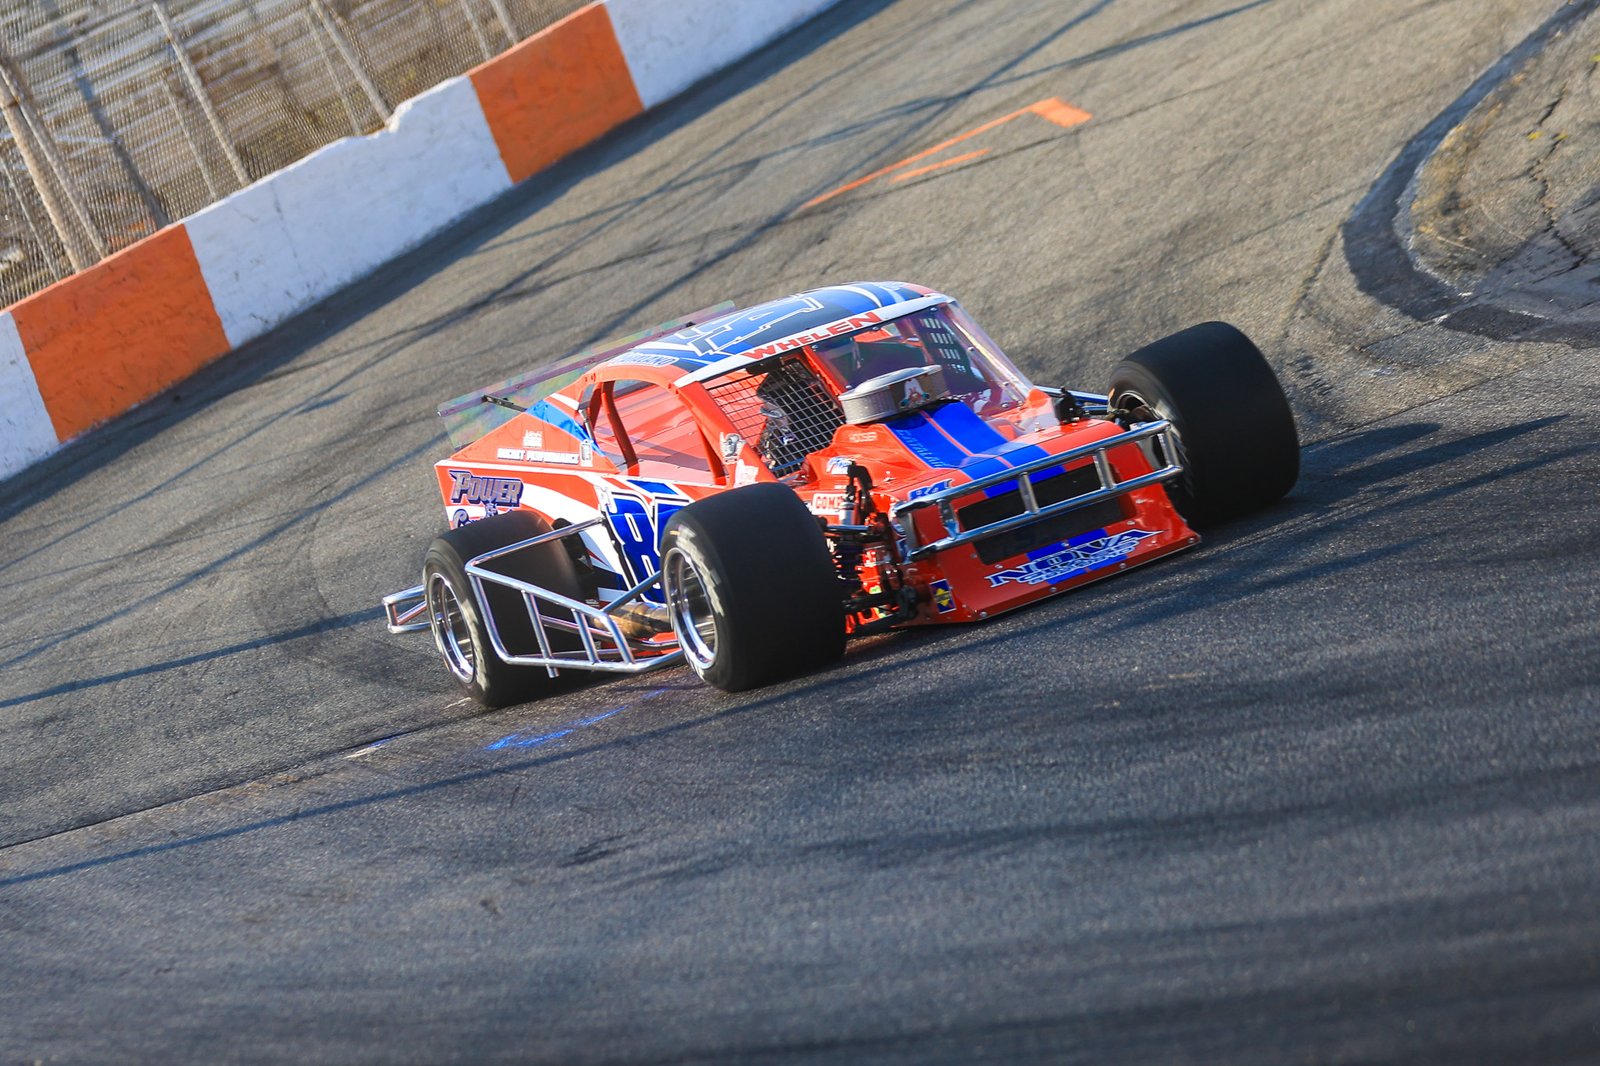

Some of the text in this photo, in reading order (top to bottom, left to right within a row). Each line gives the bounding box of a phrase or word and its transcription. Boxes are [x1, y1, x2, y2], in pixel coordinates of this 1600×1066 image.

[741, 311, 883, 360] WHELEN
[449, 470, 524, 508] POWER
[983, 529, 1166, 588] NOVA
